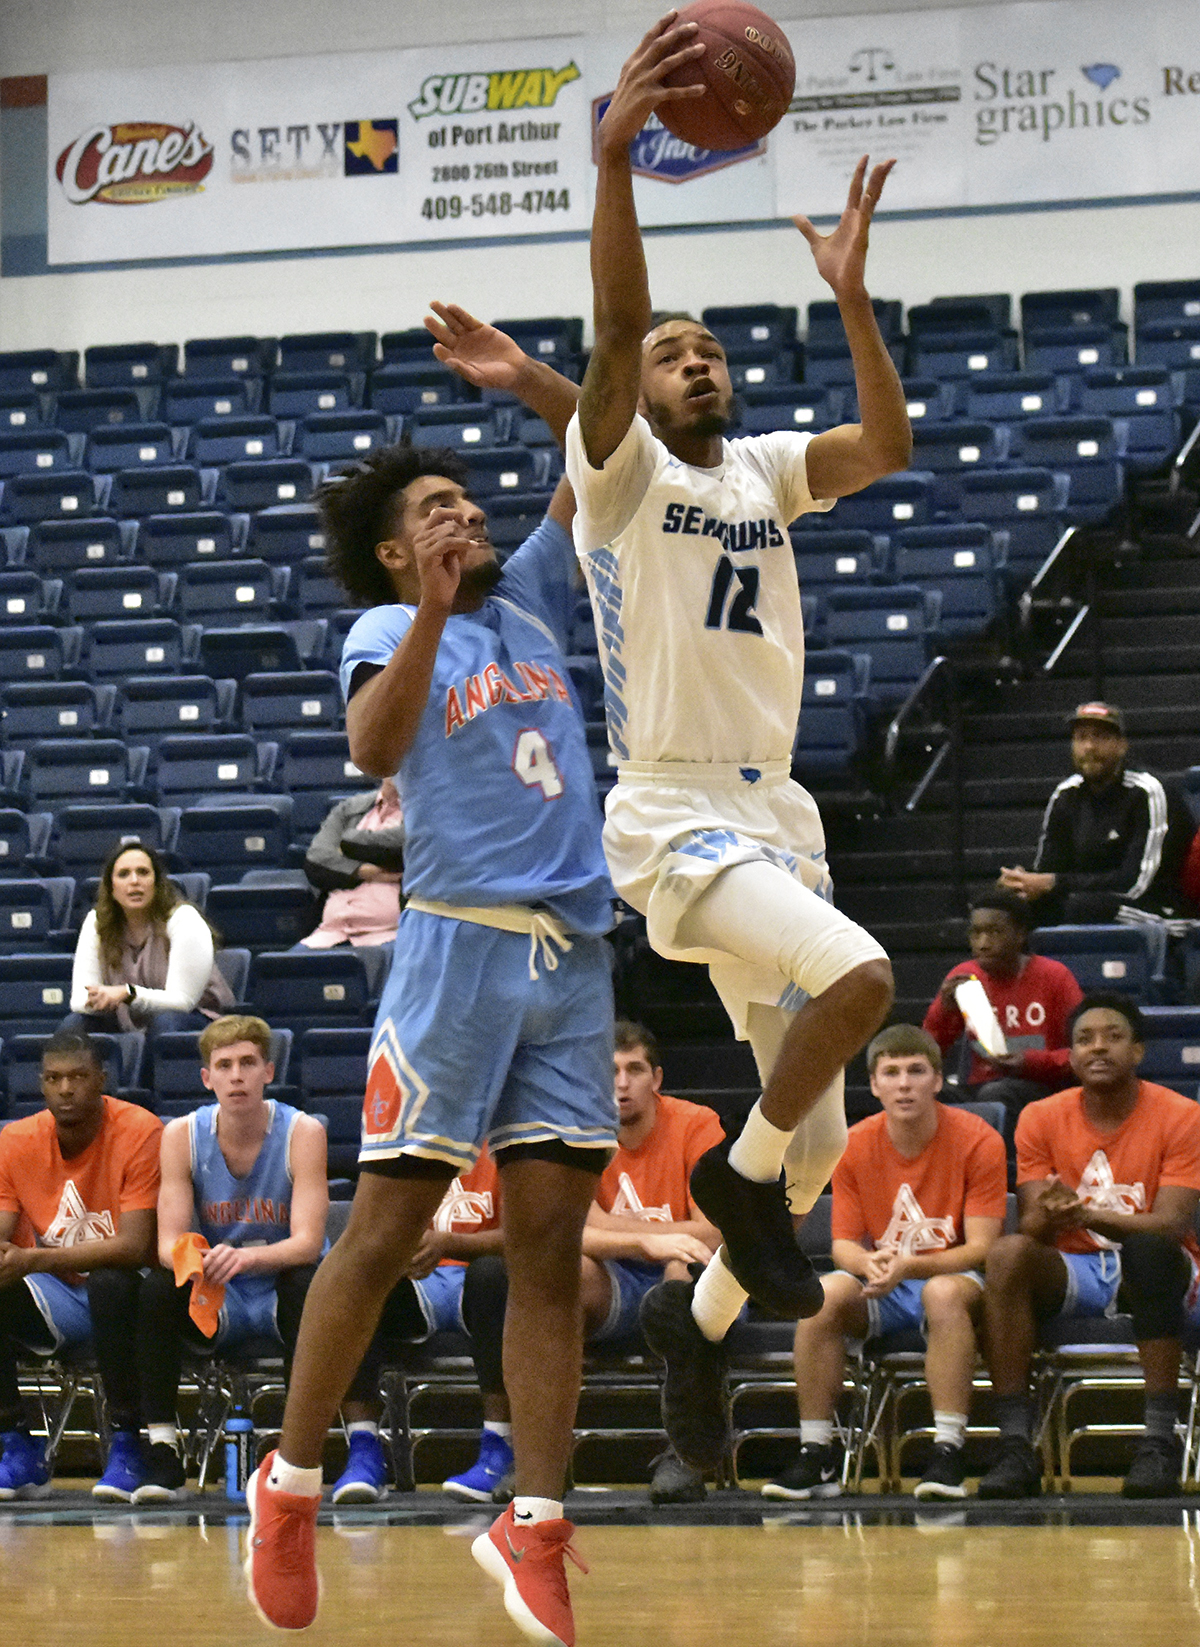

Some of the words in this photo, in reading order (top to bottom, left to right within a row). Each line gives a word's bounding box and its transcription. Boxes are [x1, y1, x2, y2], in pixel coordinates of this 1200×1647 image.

[407, 60, 581, 122] SUBWAY
[974, 62, 1055, 100] Star
[428, 126, 447, 148] of
[452, 123, 493, 147] Port
[498, 120, 561, 144] Arthur
[878, 113, 906, 127] Law
[912, 110, 948, 124] Firm
[975, 88, 1150, 146] graphics
[231, 122, 342, 161] SETX
[474, 161, 509, 181] 26th
[512, 159, 559, 178] Street
[421, 187, 570, 220] 409-548-4744
[704, 553, 765, 638] 12
[511, 727, 566, 803] 4
